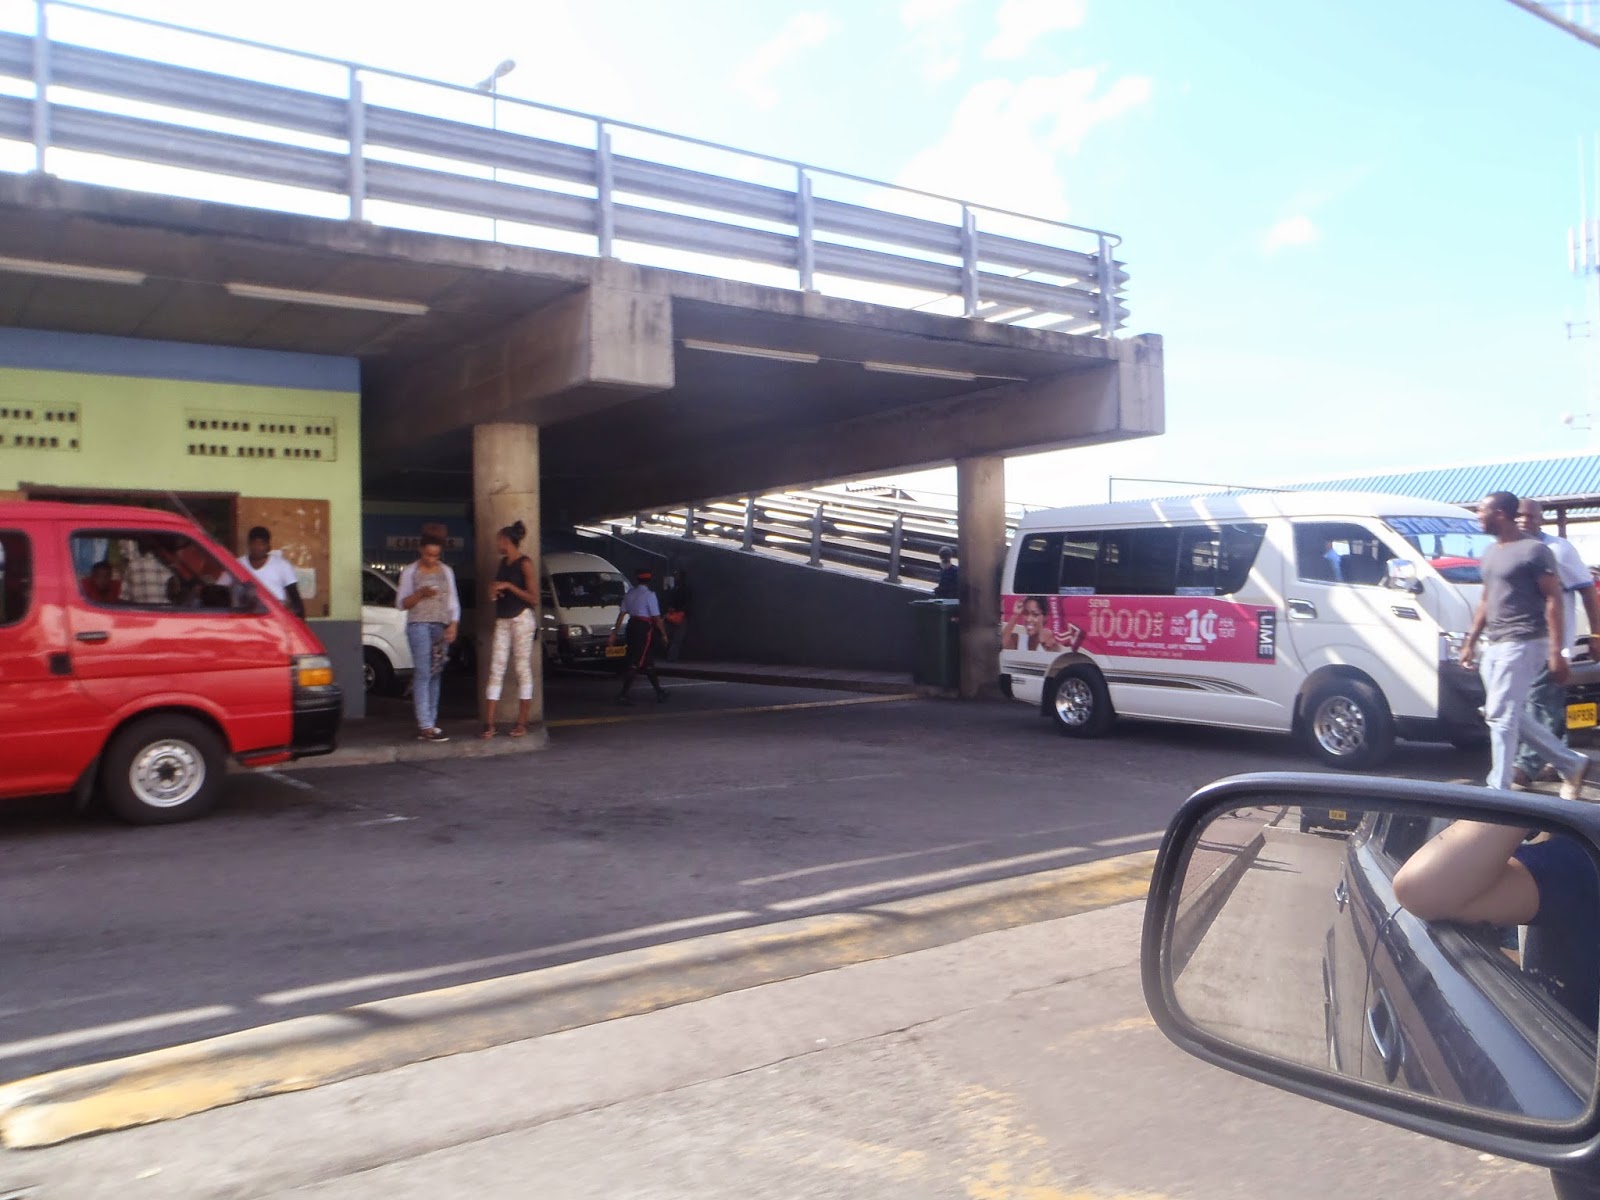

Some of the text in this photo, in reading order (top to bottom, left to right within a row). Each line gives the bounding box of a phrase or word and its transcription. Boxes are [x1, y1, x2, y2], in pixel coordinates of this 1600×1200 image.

[1088, 599, 1110, 608] SEND
[1088, 608, 1151, 639] 1000
[1259, 615, 1274, 655] LIME
